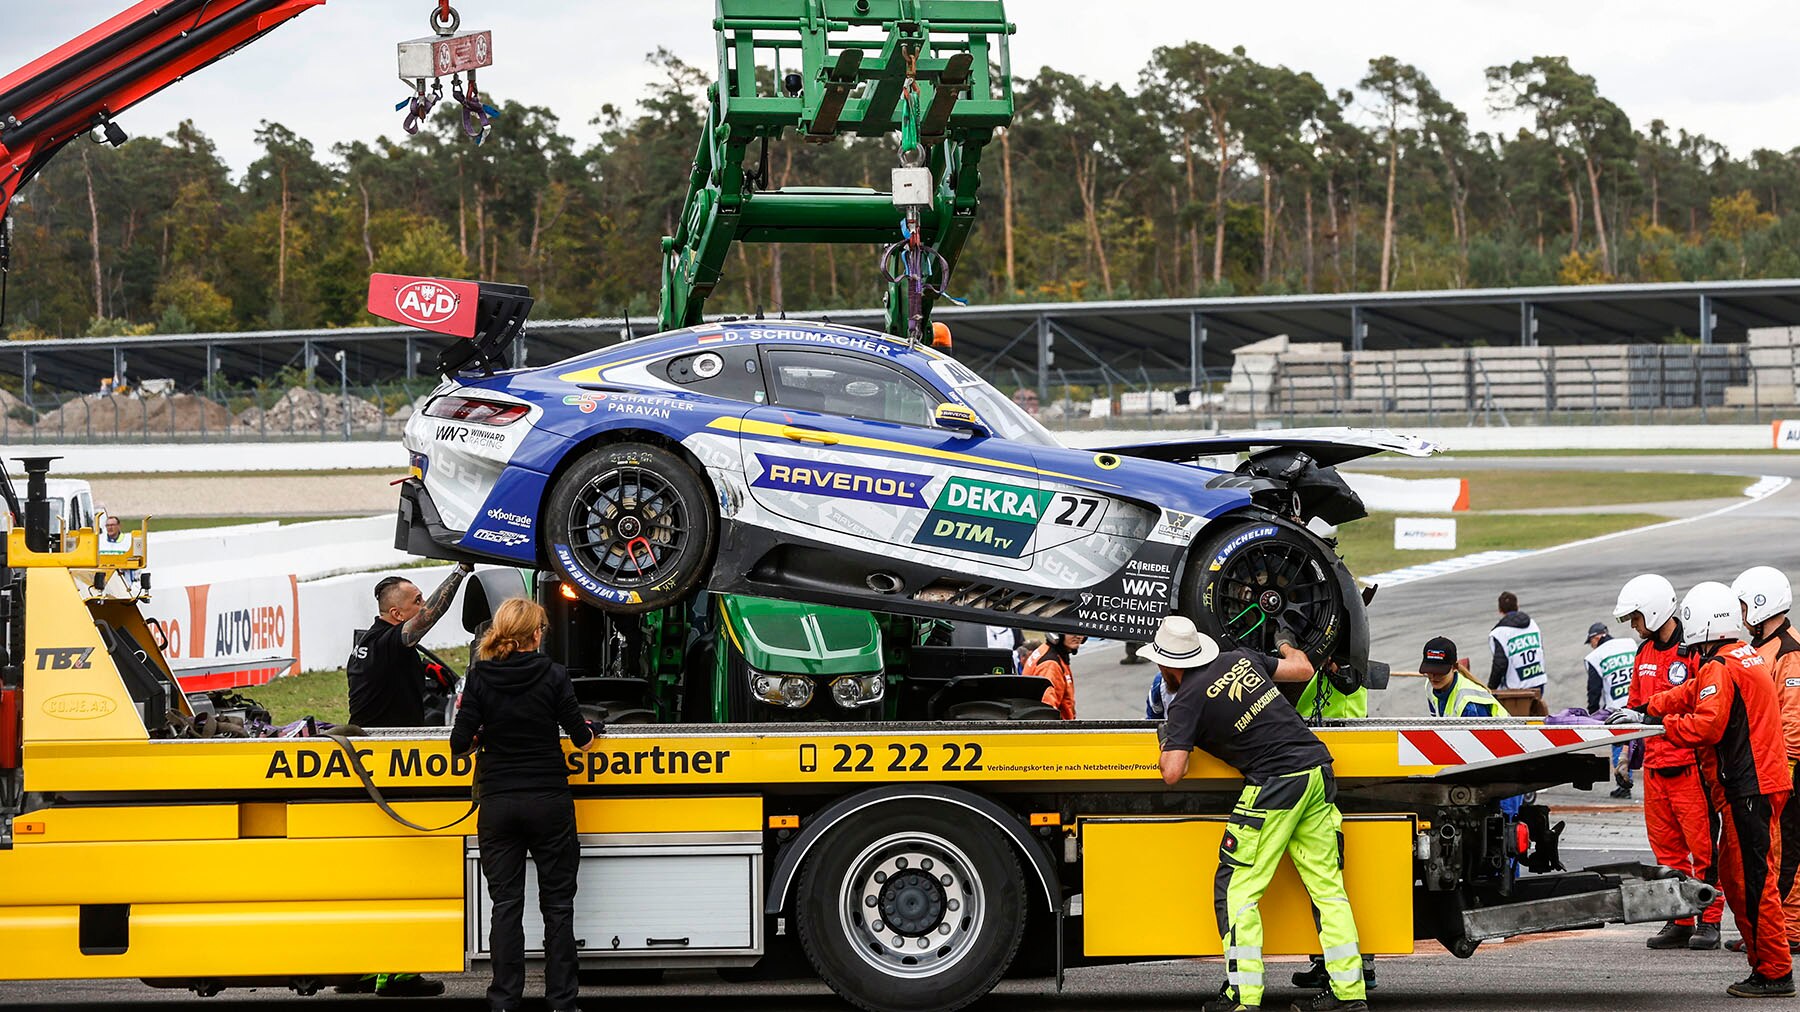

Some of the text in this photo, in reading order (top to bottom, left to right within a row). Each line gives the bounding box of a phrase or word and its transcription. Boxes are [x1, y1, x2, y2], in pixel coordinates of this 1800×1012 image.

[725, 330, 891, 355] D. SCHUMACHER
[608, 403, 670, 419] PARAVAN
[609, 394, 694, 411] SCHAEFFLER
[469, 436, 503, 450] RACING
[470, 428, 505, 442] WINWARD
[769, 464, 914, 498] RAVENOL
[947, 483, 1038, 519] DEKRA
[1054, 496, 1099, 528] 27
[933, 519, 1013, 549] DTM TV
[1223, 527, 1274, 556] MICHELIN
[558, 550, 615, 599] MICHELIN
[1142, 562, 1171, 573] RIEDEL
[1095, 595, 1164, 613] TECHEMET
[1078, 609, 1163, 627] WACKENHUT
[1078, 621, 1157, 636] PERFECT DRIV
[215, 604, 285, 657] AUTOHERO
[1508, 634, 1539, 654] DEKRA
[35, 647, 95, 670] TBZ
[1206, 657, 1252, 698] GROSS
[1614, 685, 1630, 697] DT
[1234, 711, 1254, 732] TEAM
[265, 749, 374, 778] ADAC
[833, 743, 874, 772] 22
[887, 743, 928, 771] 22
[942, 743, 983, 771] 22
[1056, 764, 1063, 772] je
[1064, 763, 1081, 771] nach
